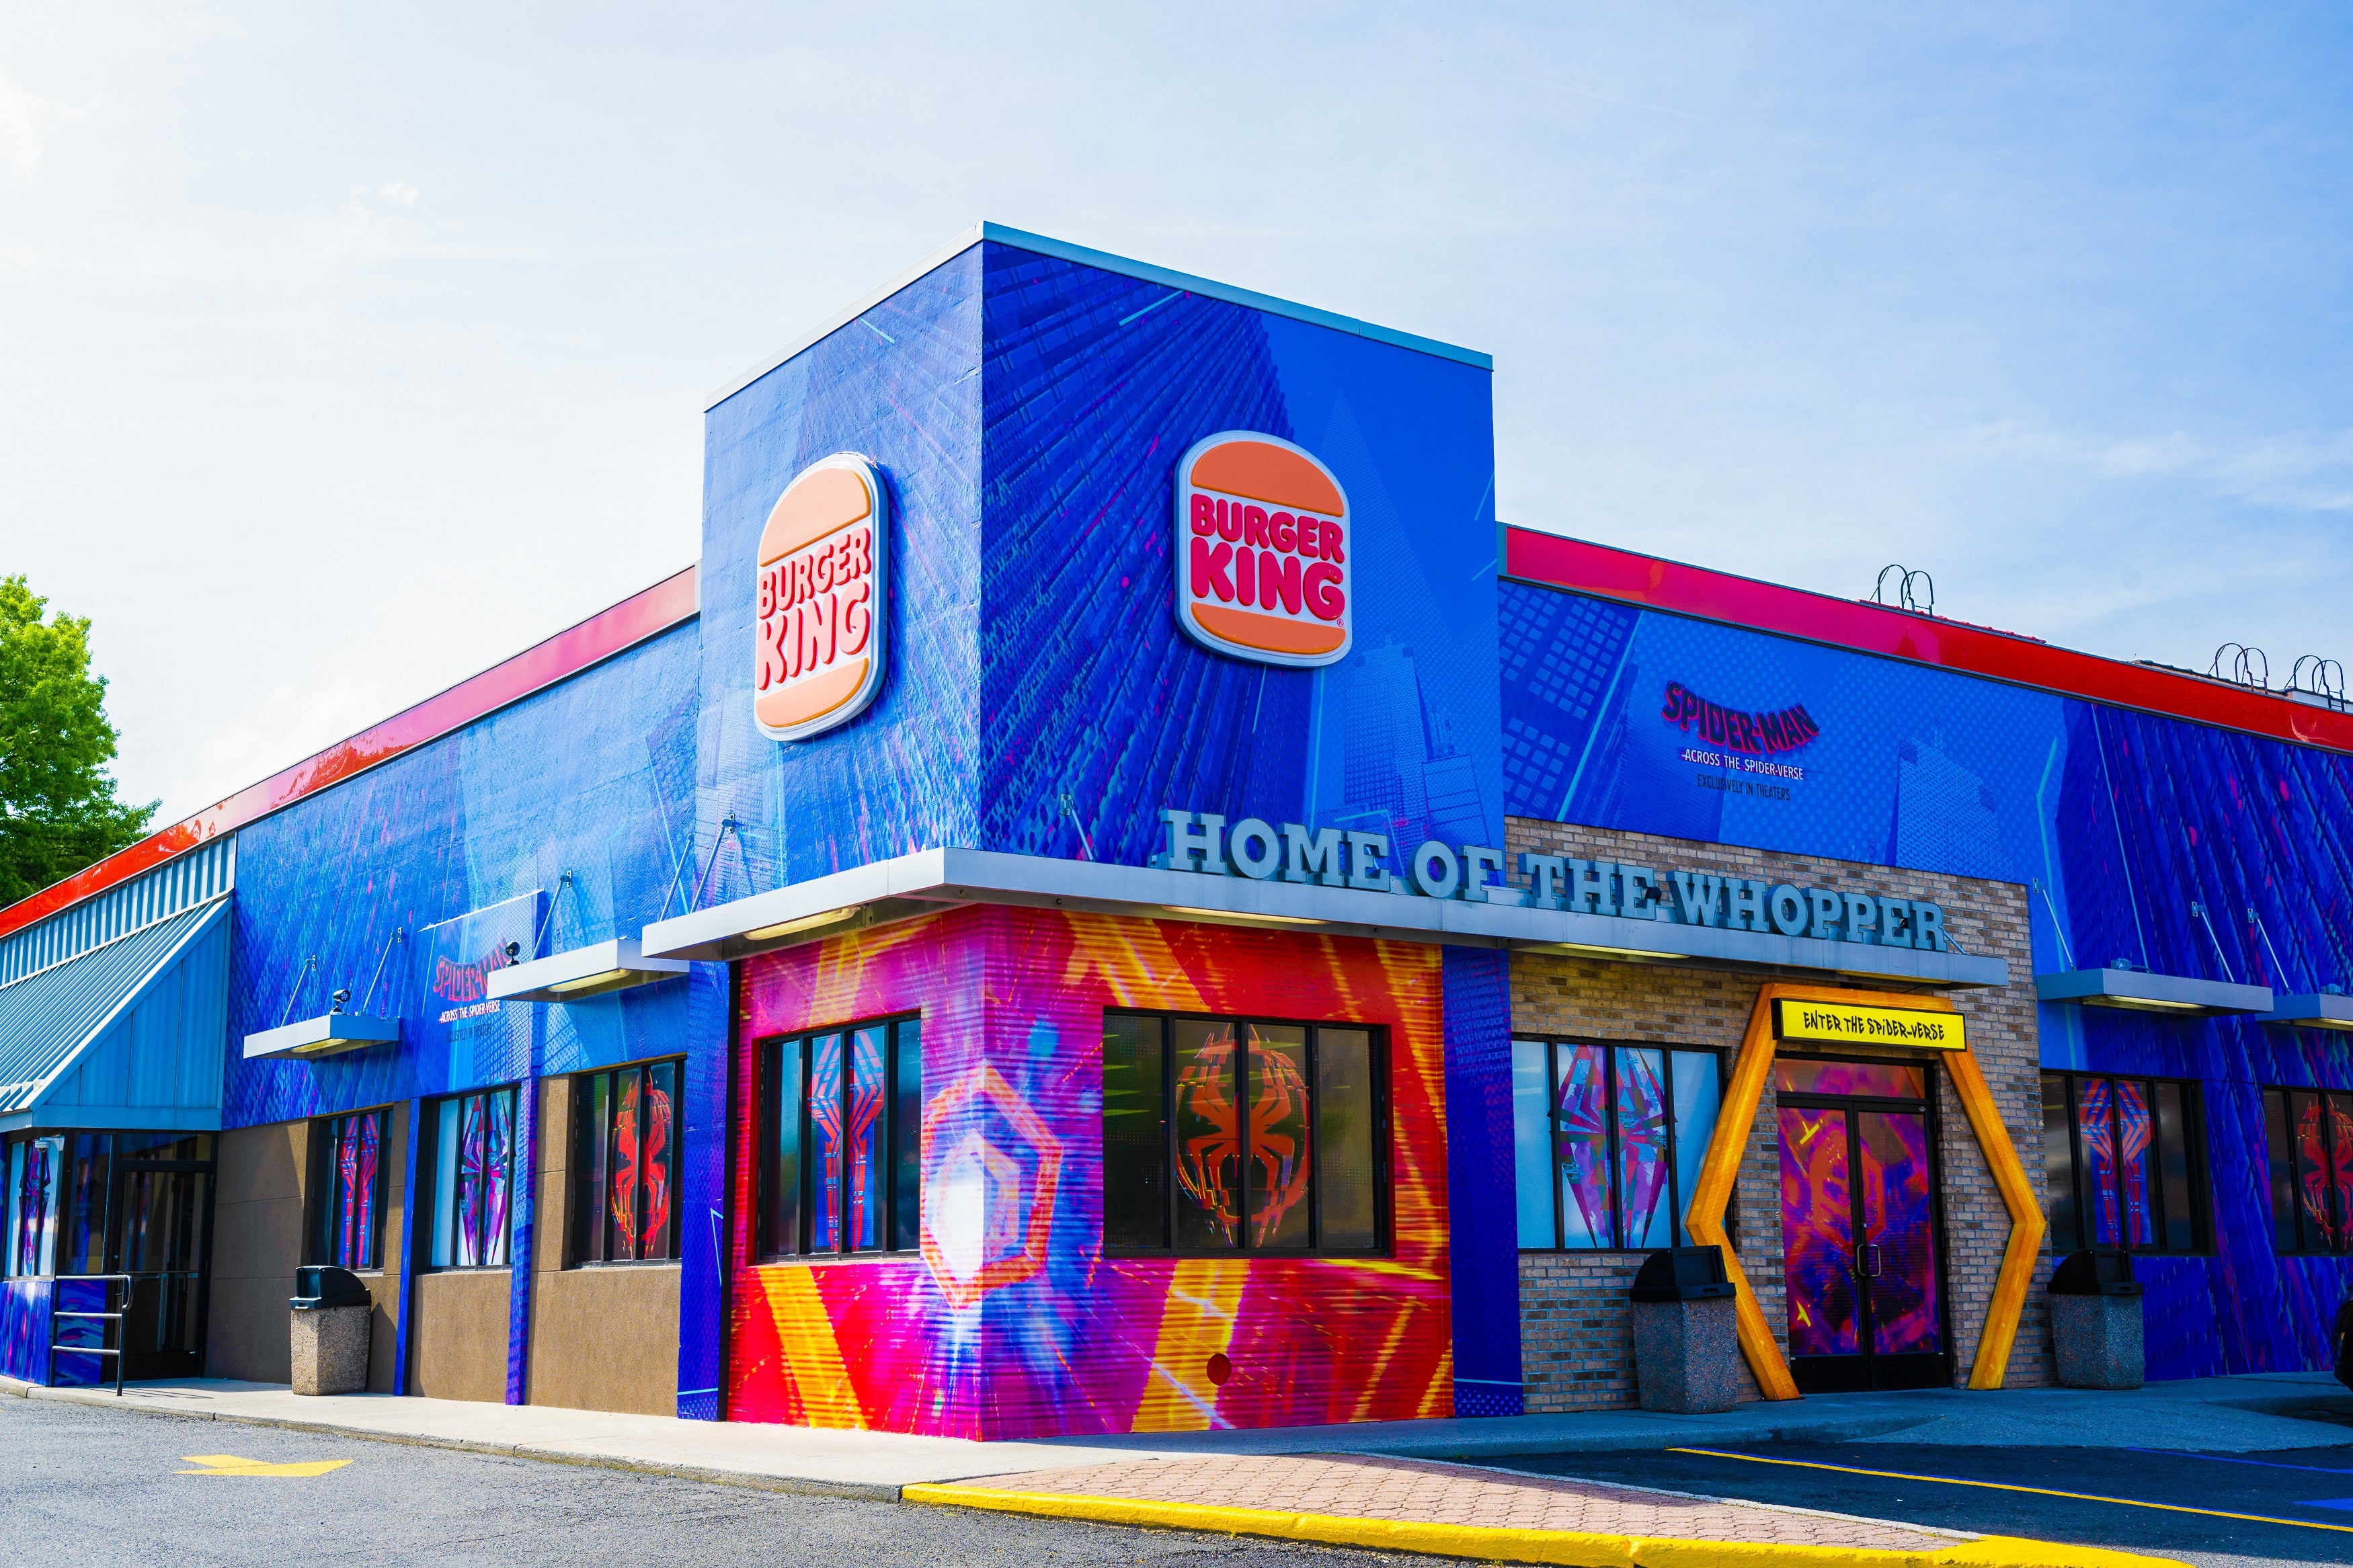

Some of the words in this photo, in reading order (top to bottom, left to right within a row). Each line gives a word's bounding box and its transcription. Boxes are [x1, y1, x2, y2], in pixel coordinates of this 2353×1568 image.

[1191, 493, 1345, 564] BURGER
[758, 527, 872, 620] BURGER
[1191, 536, 1345, 620] KING
[756, 581, 869, 691] KING
[1661, 679, 1820, 755] SPIDER-MAN
[1683, 748, 1720, 766] ACROSS
[1723, 755, 1741, 770] THE
[1745, 759, 1804, 780] SPIDER-VERSE
[1698, 774, 1743, 794] EXCLUSIVELY
[1746, 782, 1754, 796] IN
[1755, 783, 1790, 801] THEATERS
[1160, 809, 1391, 893] HOME
[1408, 839, 1503, 903] OF
[1518, 852, 1657, 921] THE
[1666, 870, 1948, 953] WHOPPER
[439, 1009, 458, 1024] ACROSS
[458, 1007, 468, 1019] THE
[469, 1000, 501, 1018] SPIDER-VERSE
[1803, 1009, 1842, 1032] ENTER
[1843, 1016, 1865, 1034] THE
